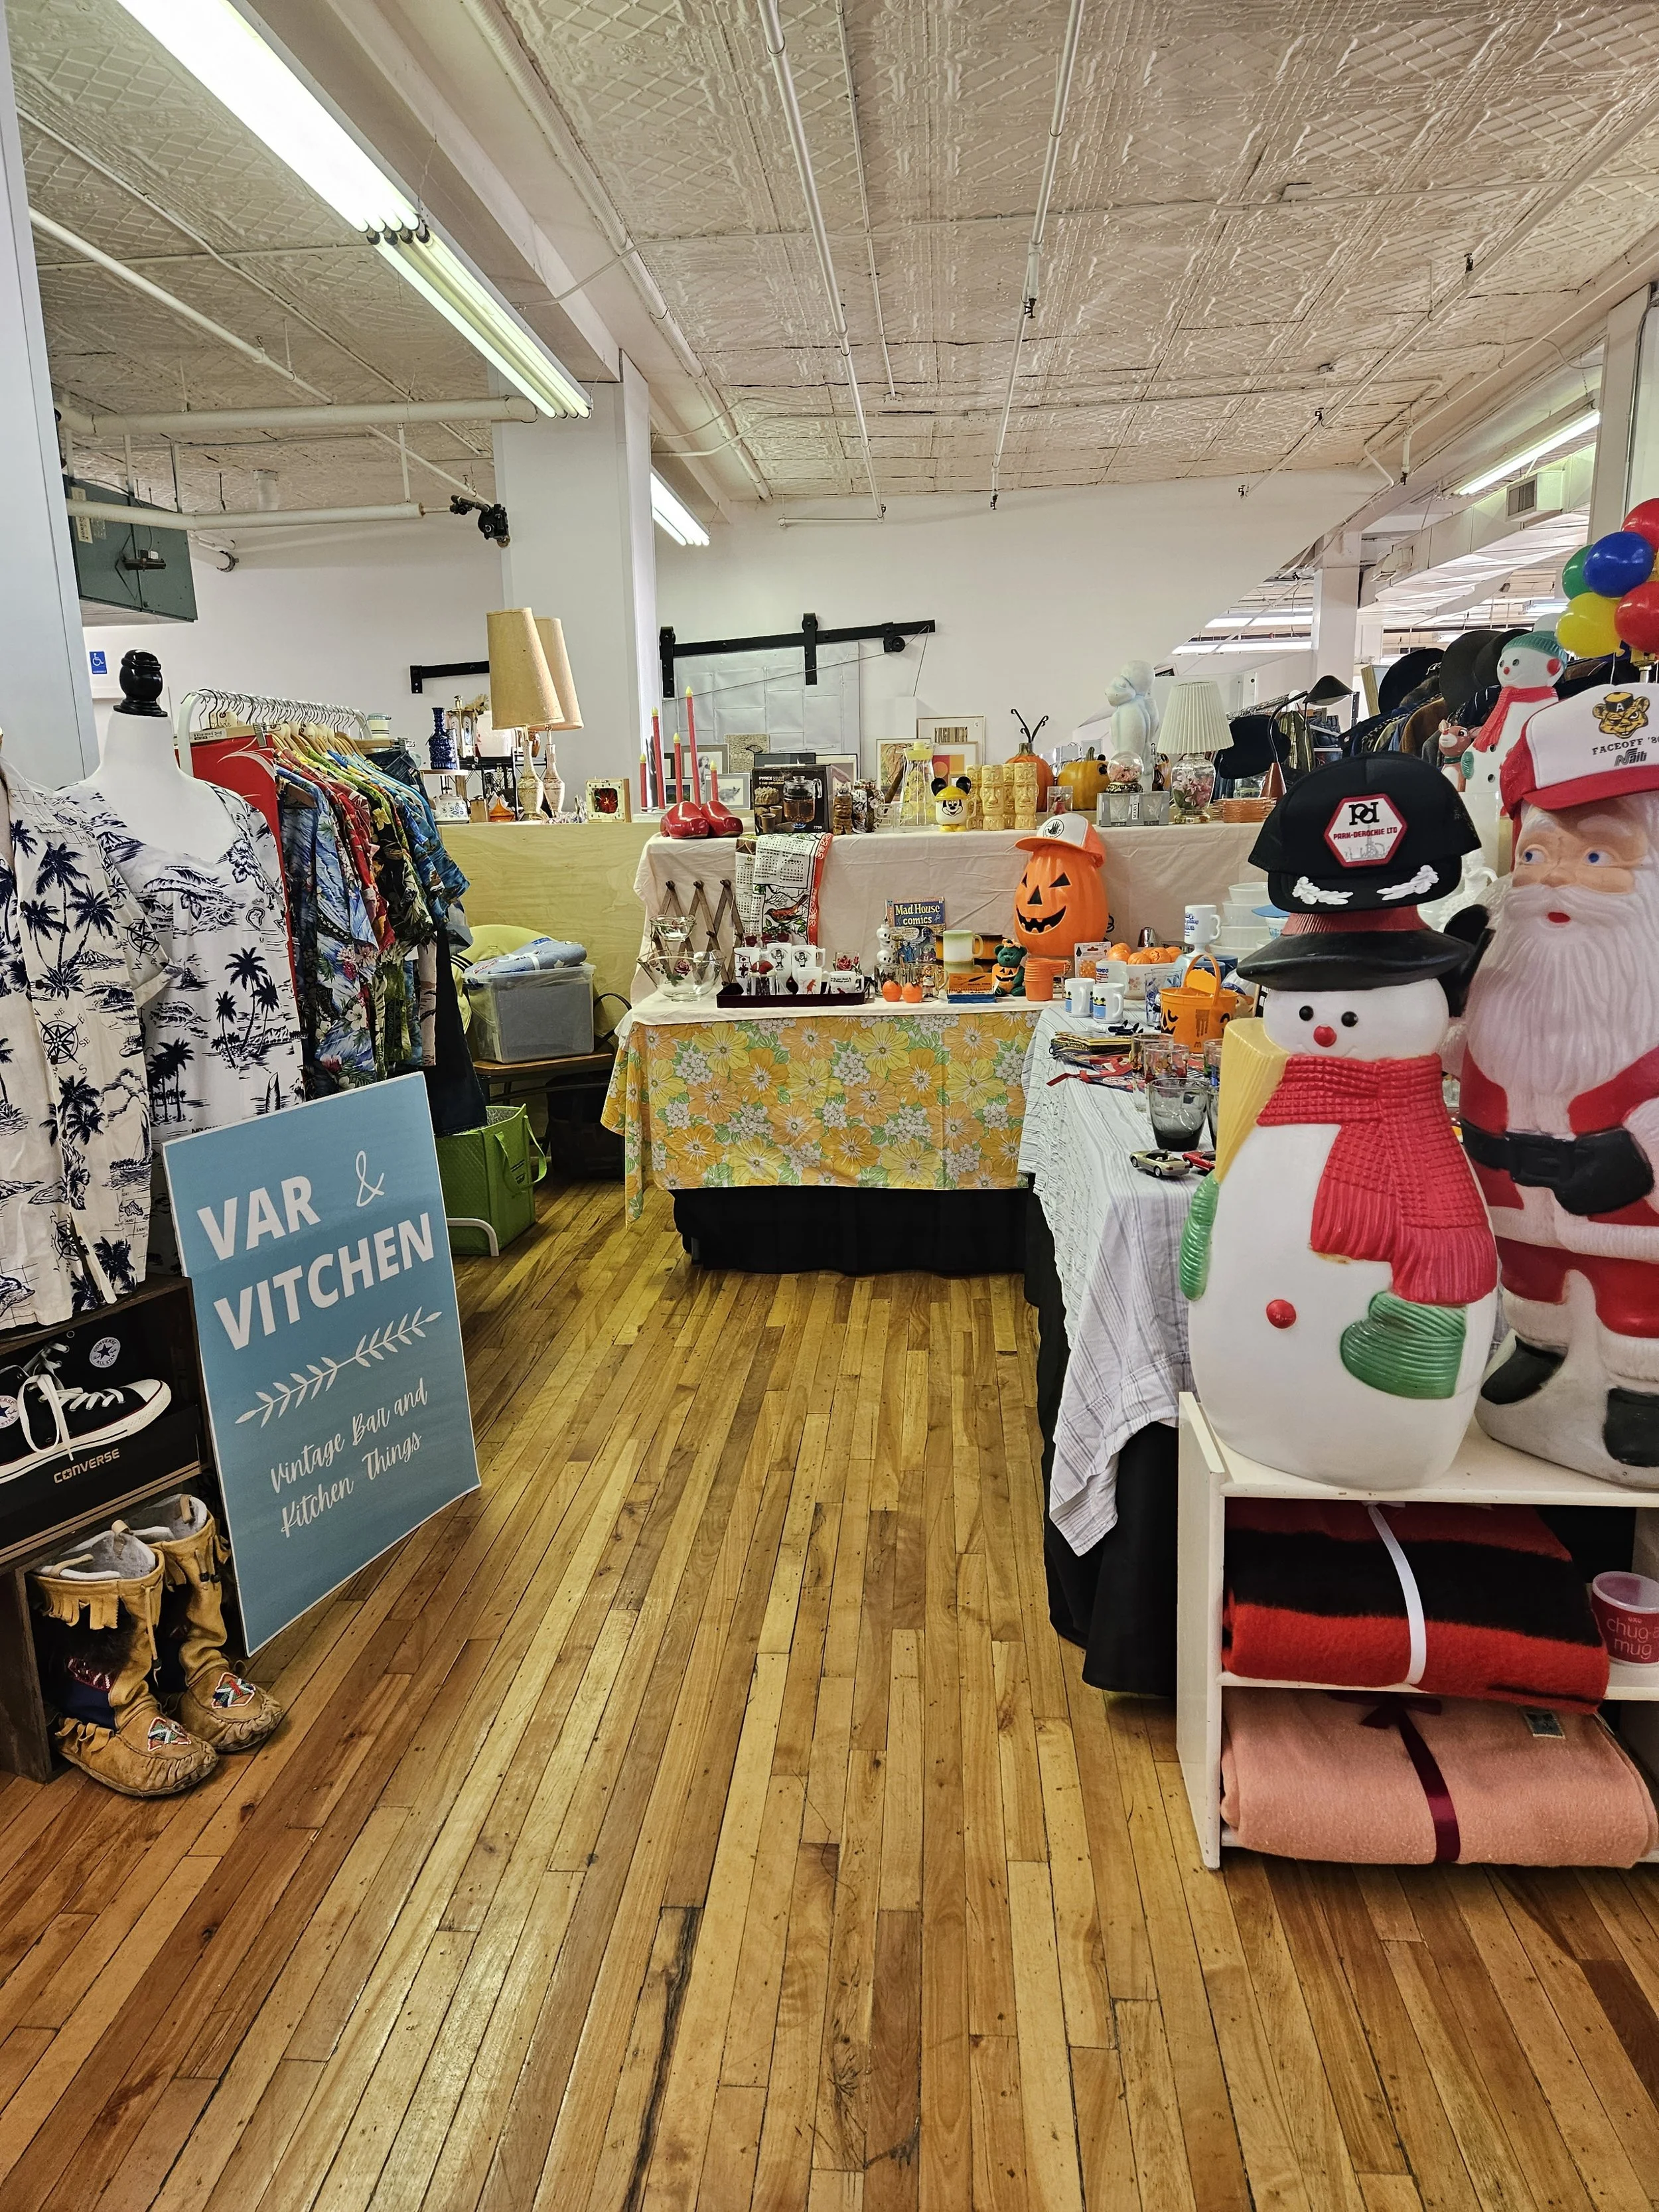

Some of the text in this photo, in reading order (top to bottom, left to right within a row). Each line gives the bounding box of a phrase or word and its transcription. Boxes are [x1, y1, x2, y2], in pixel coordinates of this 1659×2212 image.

[1592, 738, 1644, 755] FACEOFF
[1333, 828, 1385, 840] PARK-DEROCHIE
[895, 904, 914, 916] Mad
[914, 903, 940, 915] House
[902, 915, 932, 925] comics
[196, 1150, 385, 1261] VAR &
[213, 1212, 434, 1351] VITCHEN
[93, 1338, 117, 1353] CONVERSE
[106, 1354, 115, 1364] STAR
[270, 1377, 427, 1493] Vintage Bar and
[54, 1448, 120, 1484] CONVERSE
[281, 1432, 422, 1538] Kitchen Things
[1614, 1638, 1652, 1660] mug
